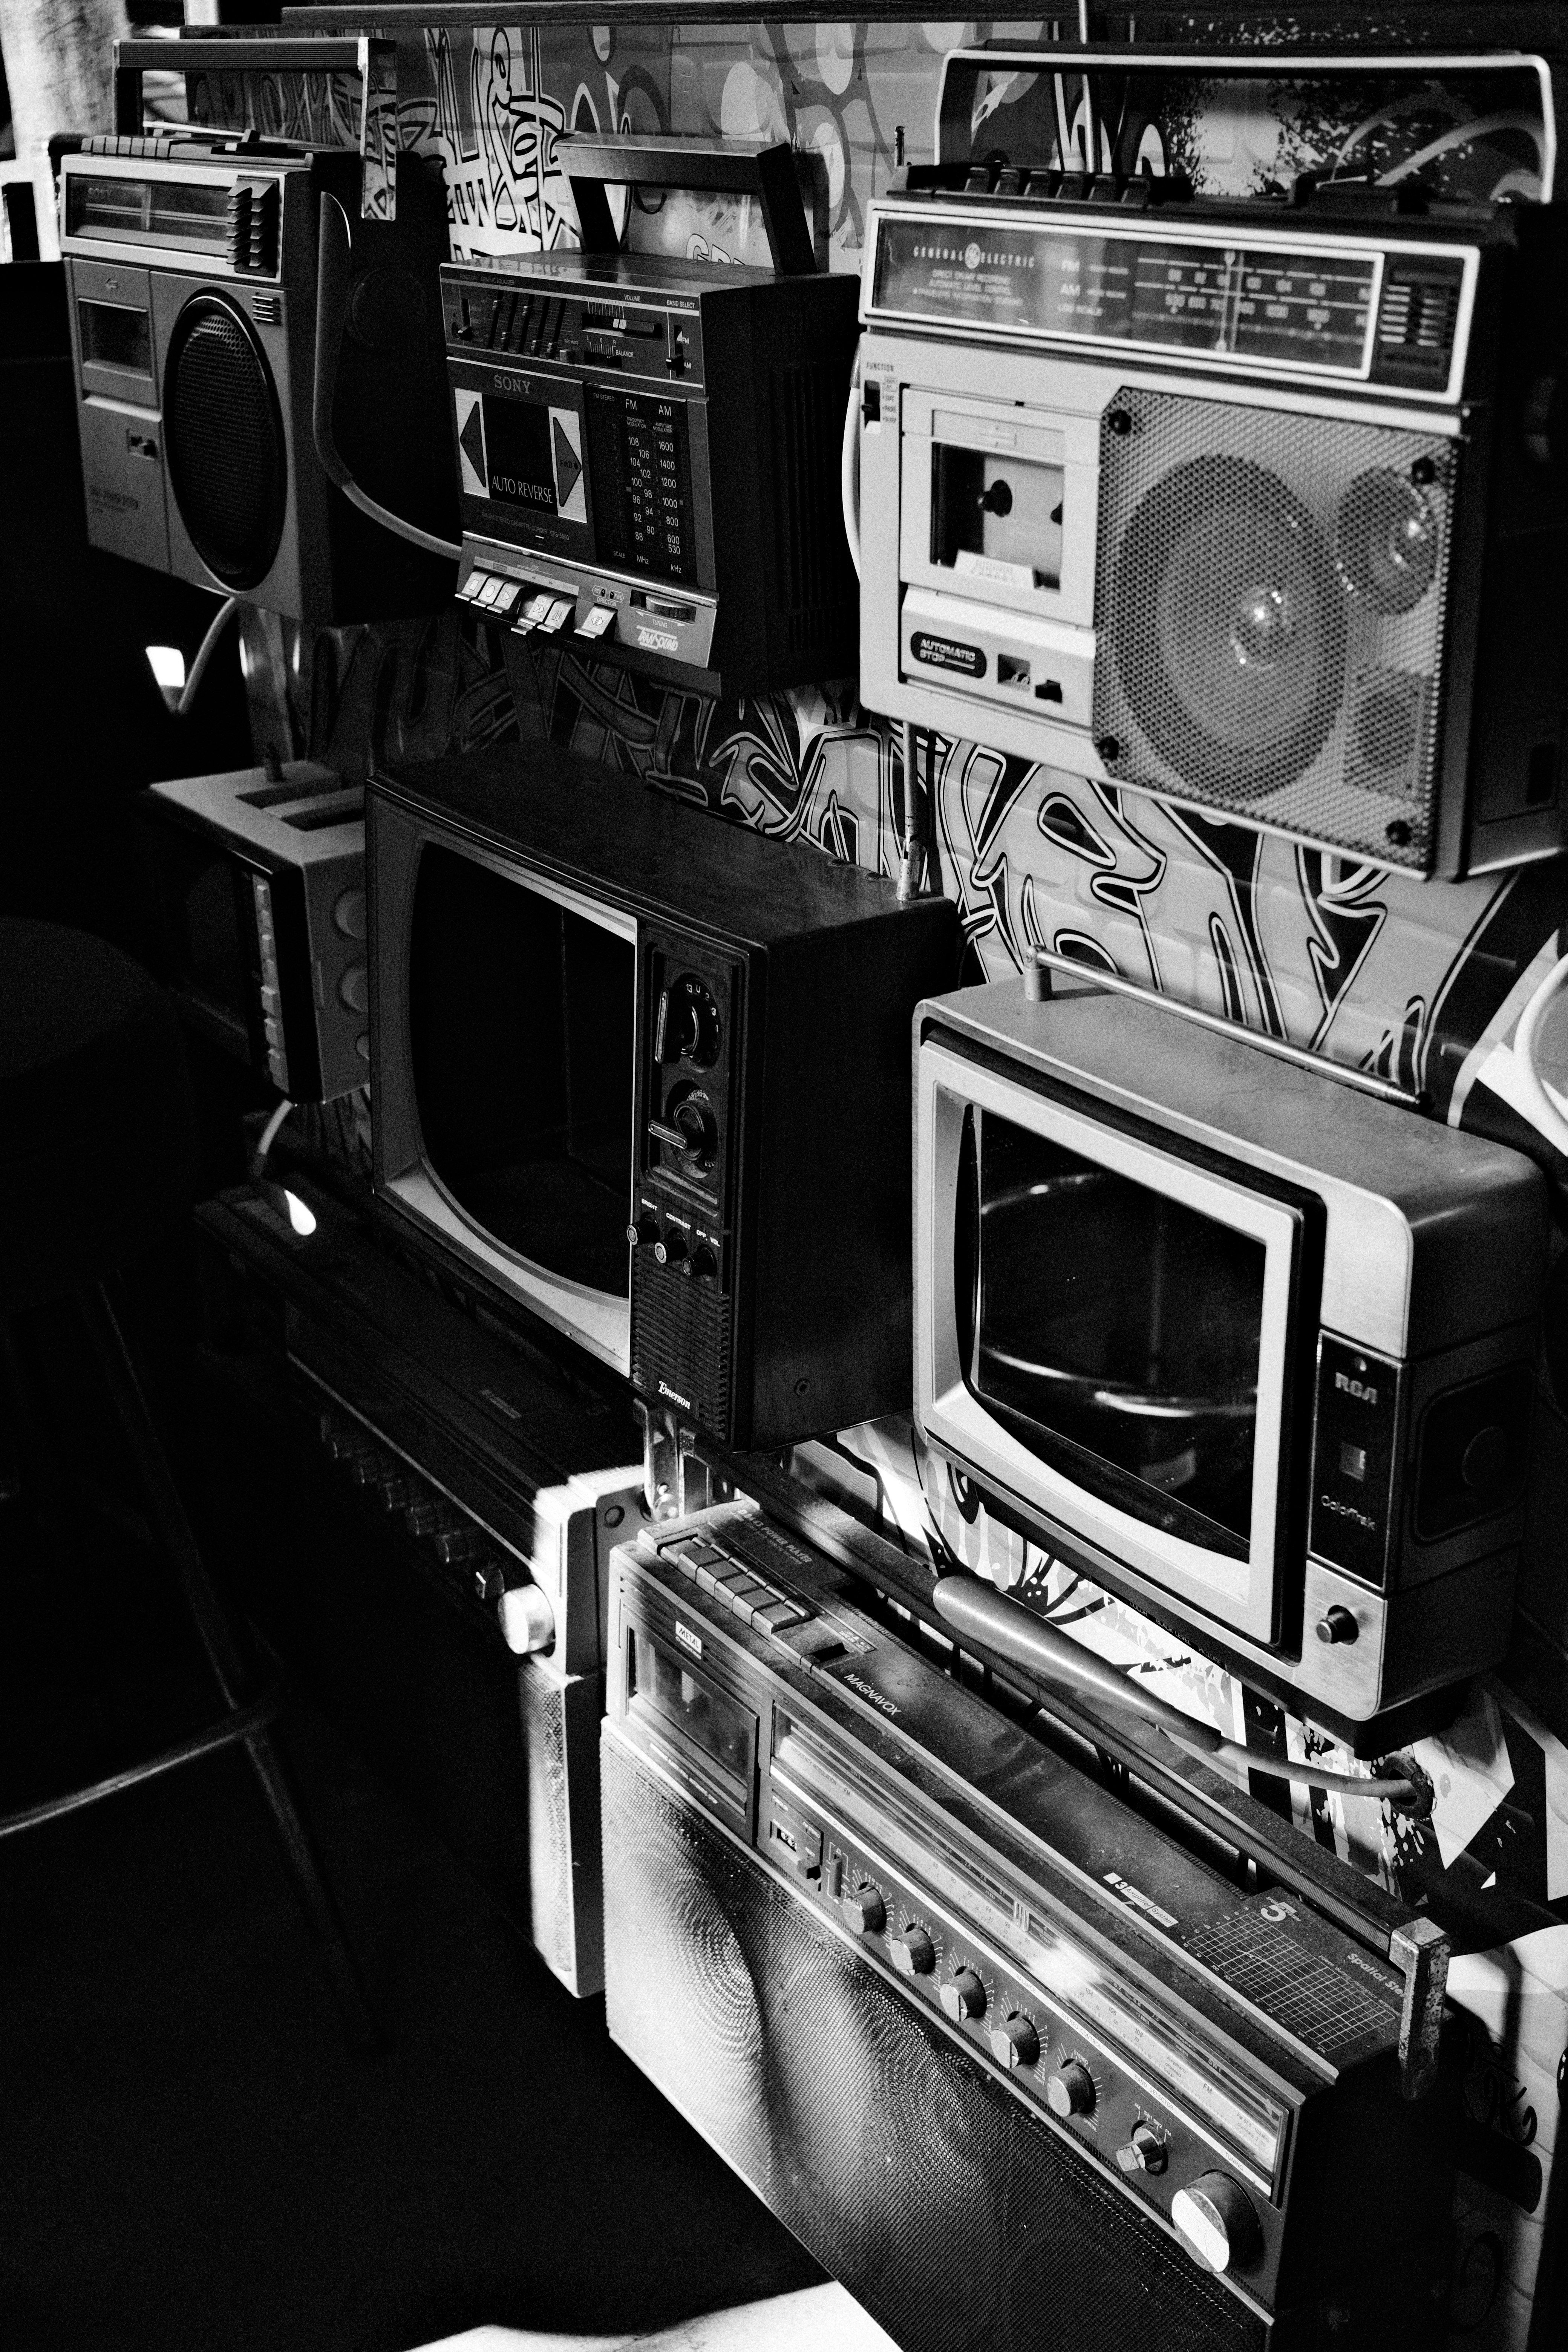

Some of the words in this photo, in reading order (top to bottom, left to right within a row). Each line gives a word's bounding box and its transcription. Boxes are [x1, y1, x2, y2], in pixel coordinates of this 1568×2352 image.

[913, 246, 963, 262] GENERAL
[980, 251, 1034, 268] ELECTRIC
[494, 374, 531, 394] SONY
[625, 398, 637, 410] FM
[658, 405, 671, 416] AM
[628, 436, 639, 446] 108
[658, 441, 674, 452] 1600
[639, 449, 649, 459] 106
[560, 459, 573, 469] FWD
[630, 457, 640, 467] 104
[660, 459, 675, 470] 1400
[640, 469, 651, 479] 102
[631, 477, 642, 487] 100
[661, 477, 676, 488] 1200
[492, 475, 516, 494] AUTO
[517, 481, 553, 504] REVERSE
[644, 488, 652, 498] 98
[632, 495, 641, 504] 96
[662, 497, 677, 508] 1000
[634, 513, 642, 522] 92
[645, 506, 654, 516] 94
[666, 516, 678, 527] 800
[635, 531, 643, 541] 88
[646, 525, 655, 535] 90
[667, 534, 680, 545] 600
[668, 544, 680, 554] 530
[613, 550, 626, 559] SCALE
[637, 554, 649, 565] MHz
[670, 564, 681, 573] kHz
[597, 596, 616, 606] DIRECTION
[652, 619, 668, 628] TUNING
[920, 639, 975, 662] AUTOMATIC
[920, 649, 945, 662] STOP
[686, 984, 692, 993] 13
[712, 1008, 716, 1016] 3
[642, 1198, 658, 1211] BRIGHT
[666, 1212, 691, 1230] CONTRAST
[710, 1237, 720, 1247] VOL
[1335, 1372, 1377, 1404] RCA
[658, 1380, 691, 1410] Emerson
[761, 1527, 788, 1545] POWER
[786, 1545, 813, 1563] PLAYER
[679, 1628, 699, 1649] METAL
[1174, 1631, 1192, 1646] LEVEL
[844, 1674, 902, 1715] MAGNAVOX
[813, 1763, 836, 1785] MODULATION
[843, 1787, 851, 1795] FM
[865, 1848, 880, 1862] VOLUME
[916, 1890, 926, 1902] BASS
[1115, 1881, 1128, 1890] 3
[1125, 1887, 1151, 1908] Amplifier
[1152, 1908, 1173, 1925] System
[1261, 1902, 1298, 1921] 5
[964, 1931, 980, 1946] TREBLE
[1347, 1953, 1388, 1981] Spatial
[1016, 1974, 1036, 1993] BALANCE
[1085, 1988, 1093, 1997] 104
[1108, 2006, 1117, 2016] 106
[1135, 2028, 1143, 2037] 108
[1061, 2012, 1079, 2029] STEREO
[1080, 2028, 1101, 2050] CONTROL
[1074, 2049, 1089, 2064] STEREO
[1208, 2058, 1221, 2072] SW1
[1134, 2074, 1147, 2088] BAND
[1149, 2087, 1174, 2111] SELECTOR
[1203, 2083, 1213, 2094] FM
[1144, 2110, 1152, 2120] SW1
[1165, 2128, 1172, 2136] FM
[1225, 2151, 1243, 2171] TUNING
